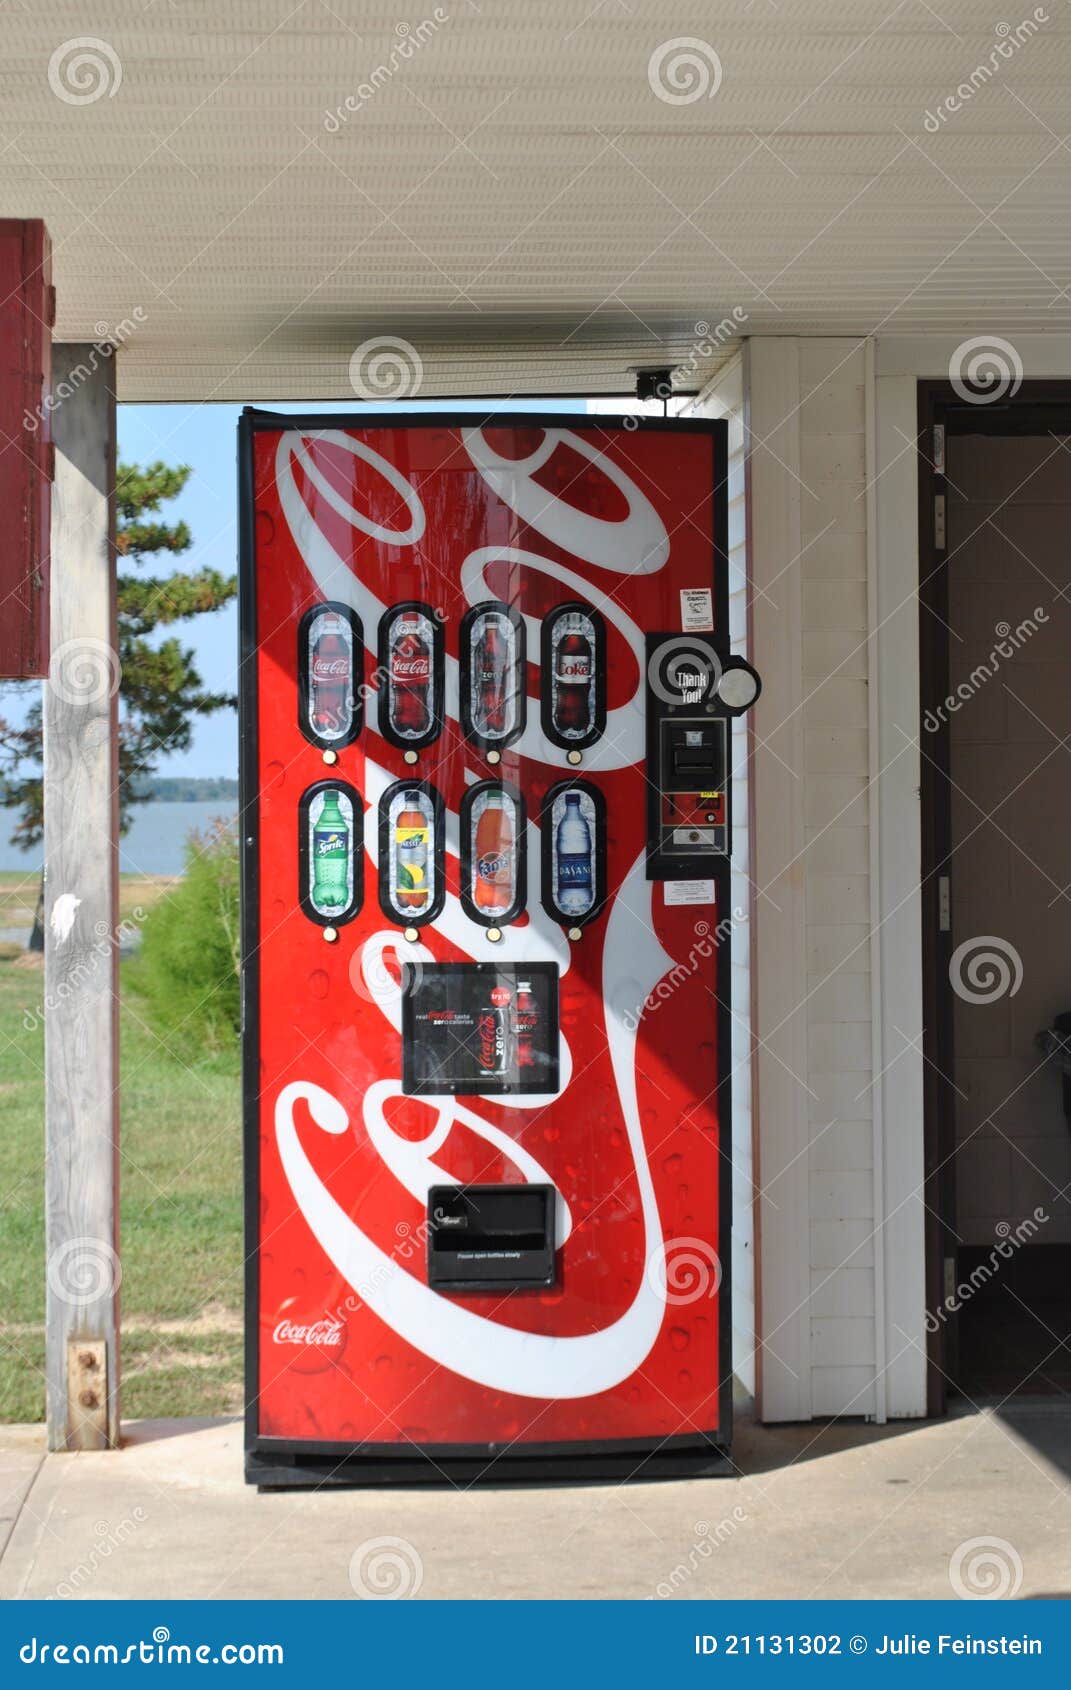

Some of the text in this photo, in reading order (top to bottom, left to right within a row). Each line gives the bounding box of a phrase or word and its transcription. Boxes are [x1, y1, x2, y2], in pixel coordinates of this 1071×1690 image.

[314, 659, 348, 675] Coca-Cola
[393, 659, 428, 675] Coca-Cola
[558, 662, 589, 675] Coke
[677, 672, 707, 687] Thank
[682, 689, 702, 704] You!
[317, 841, 345, 857] Sprite
[559, 865, 592, 877] DASANI
[496, 1026, 504, 1056] zero
[273, 1320, 344, 1345] Coca-Cola
